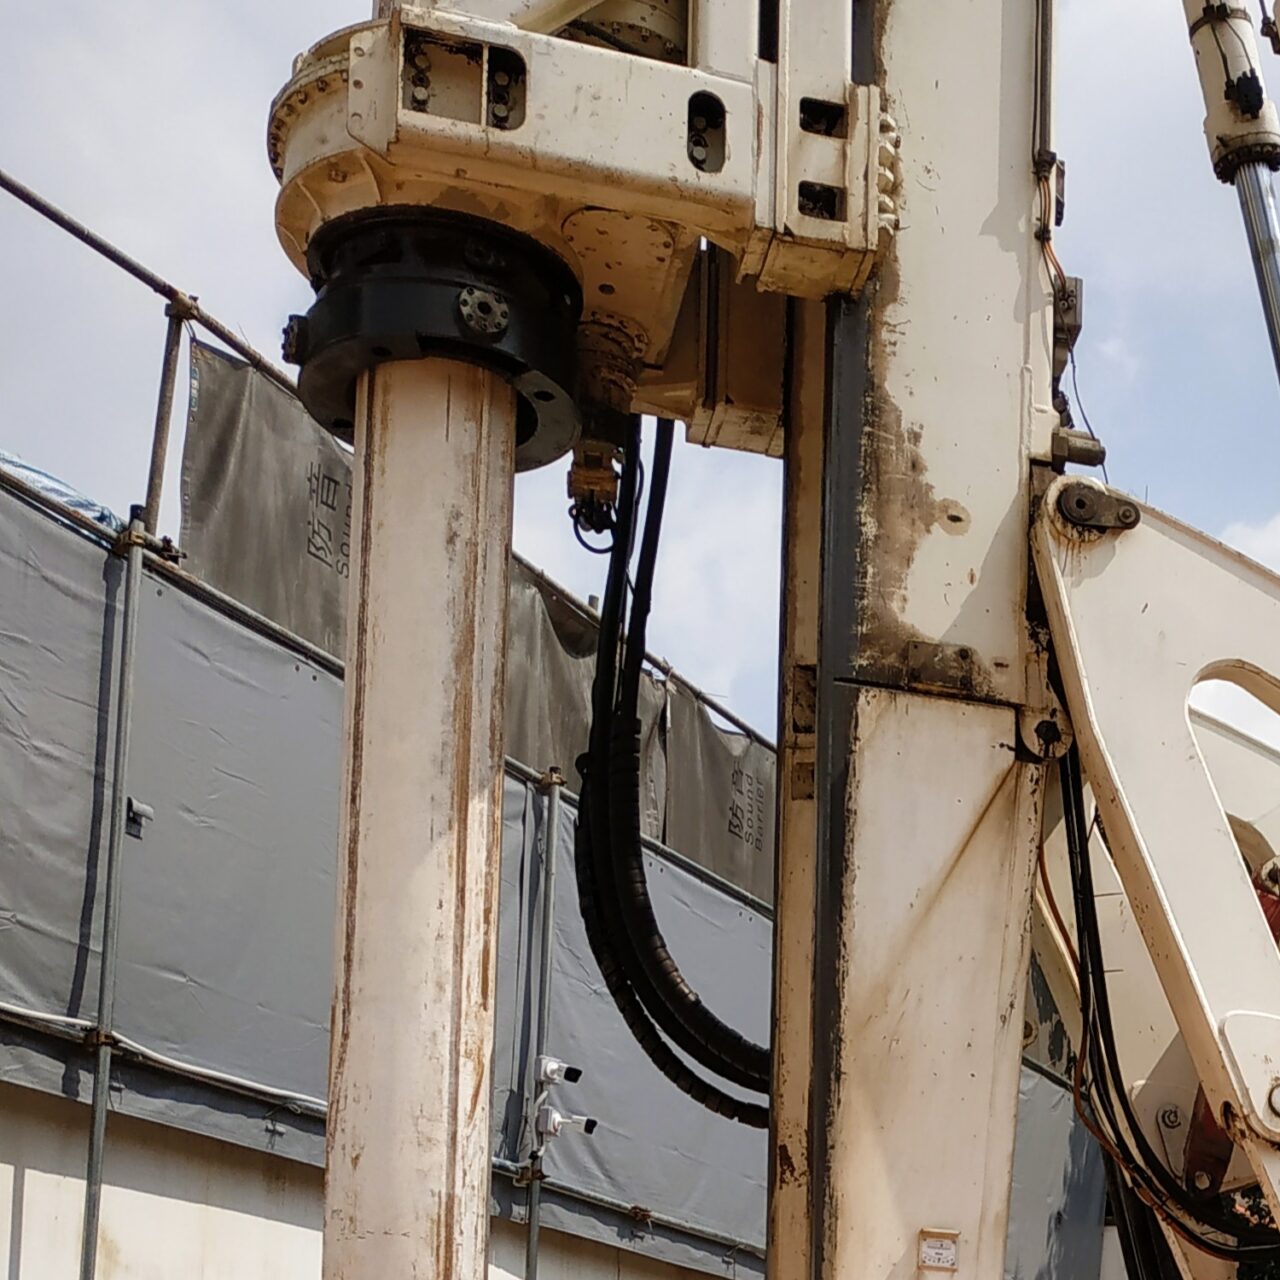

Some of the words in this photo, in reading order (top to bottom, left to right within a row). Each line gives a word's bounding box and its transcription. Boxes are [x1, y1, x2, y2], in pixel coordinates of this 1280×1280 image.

[306, 461, 340, 569] 防音
[744, 773, 754, 845] Sound
[755, 776, 764, 852] Barrier
